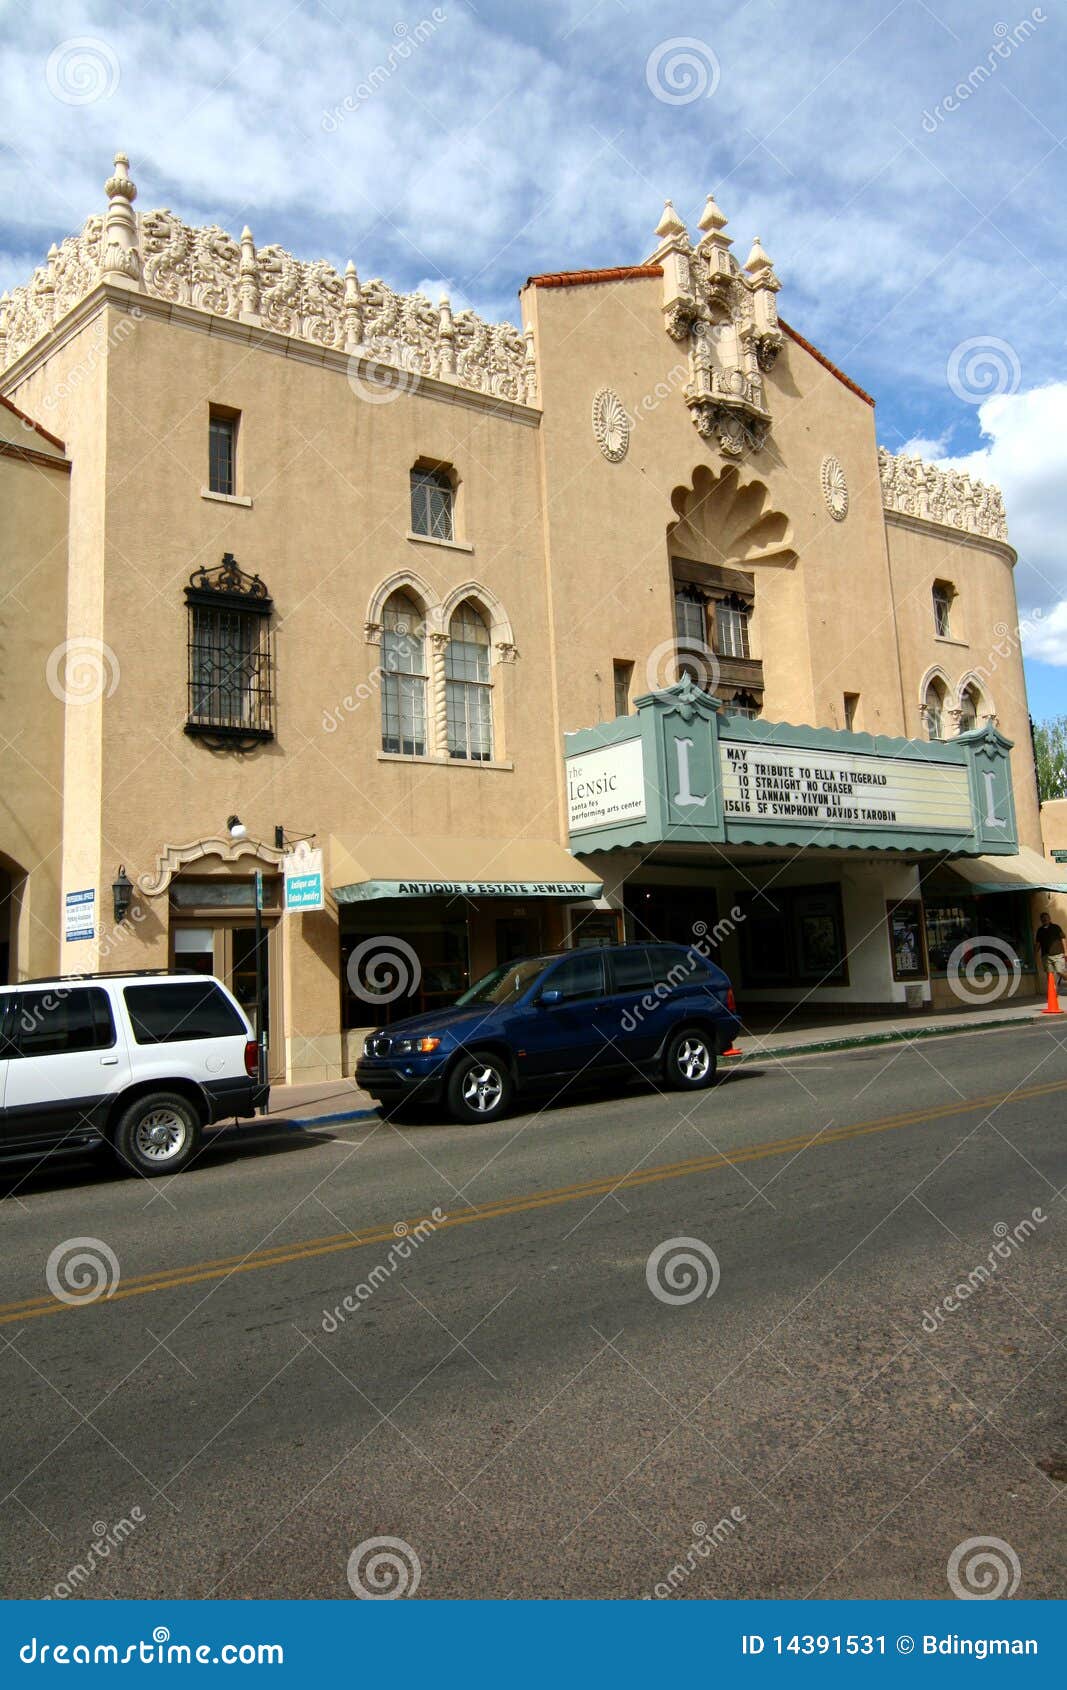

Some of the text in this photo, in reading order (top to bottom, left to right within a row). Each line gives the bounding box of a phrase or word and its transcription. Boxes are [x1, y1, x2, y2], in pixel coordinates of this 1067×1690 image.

[727, 748, 746, 760] MAY
[674, 736, 706, 807] L
[732, 762, 748, 773] 7-9
[755, 764, 794, 777] TRIBUTE
[800, 768, 810, 779] TO
[815, 769, 835, 781] ELLA
[739, 776, 853, 794] 10 STRAIGHT NO CHASER
[740, 789, 750, 800] 12
[756, 790, 790, 802] LANNAN
[802, 793, 828, 805] YIYUN
[832, 795, 841, 805] LI
[982, 770, 1007, 827] L
[571, 803, 587, 811] santa
[572, 800, 642, 821] performing arts center
[725, 800, 751, 812] 15&16
[757, 802, 768, 814] SF
[772, 803, 819, 817] SYMPHONY
[398, 883, 587, 895] ANTIQUE & ESTATE JEWELRY
